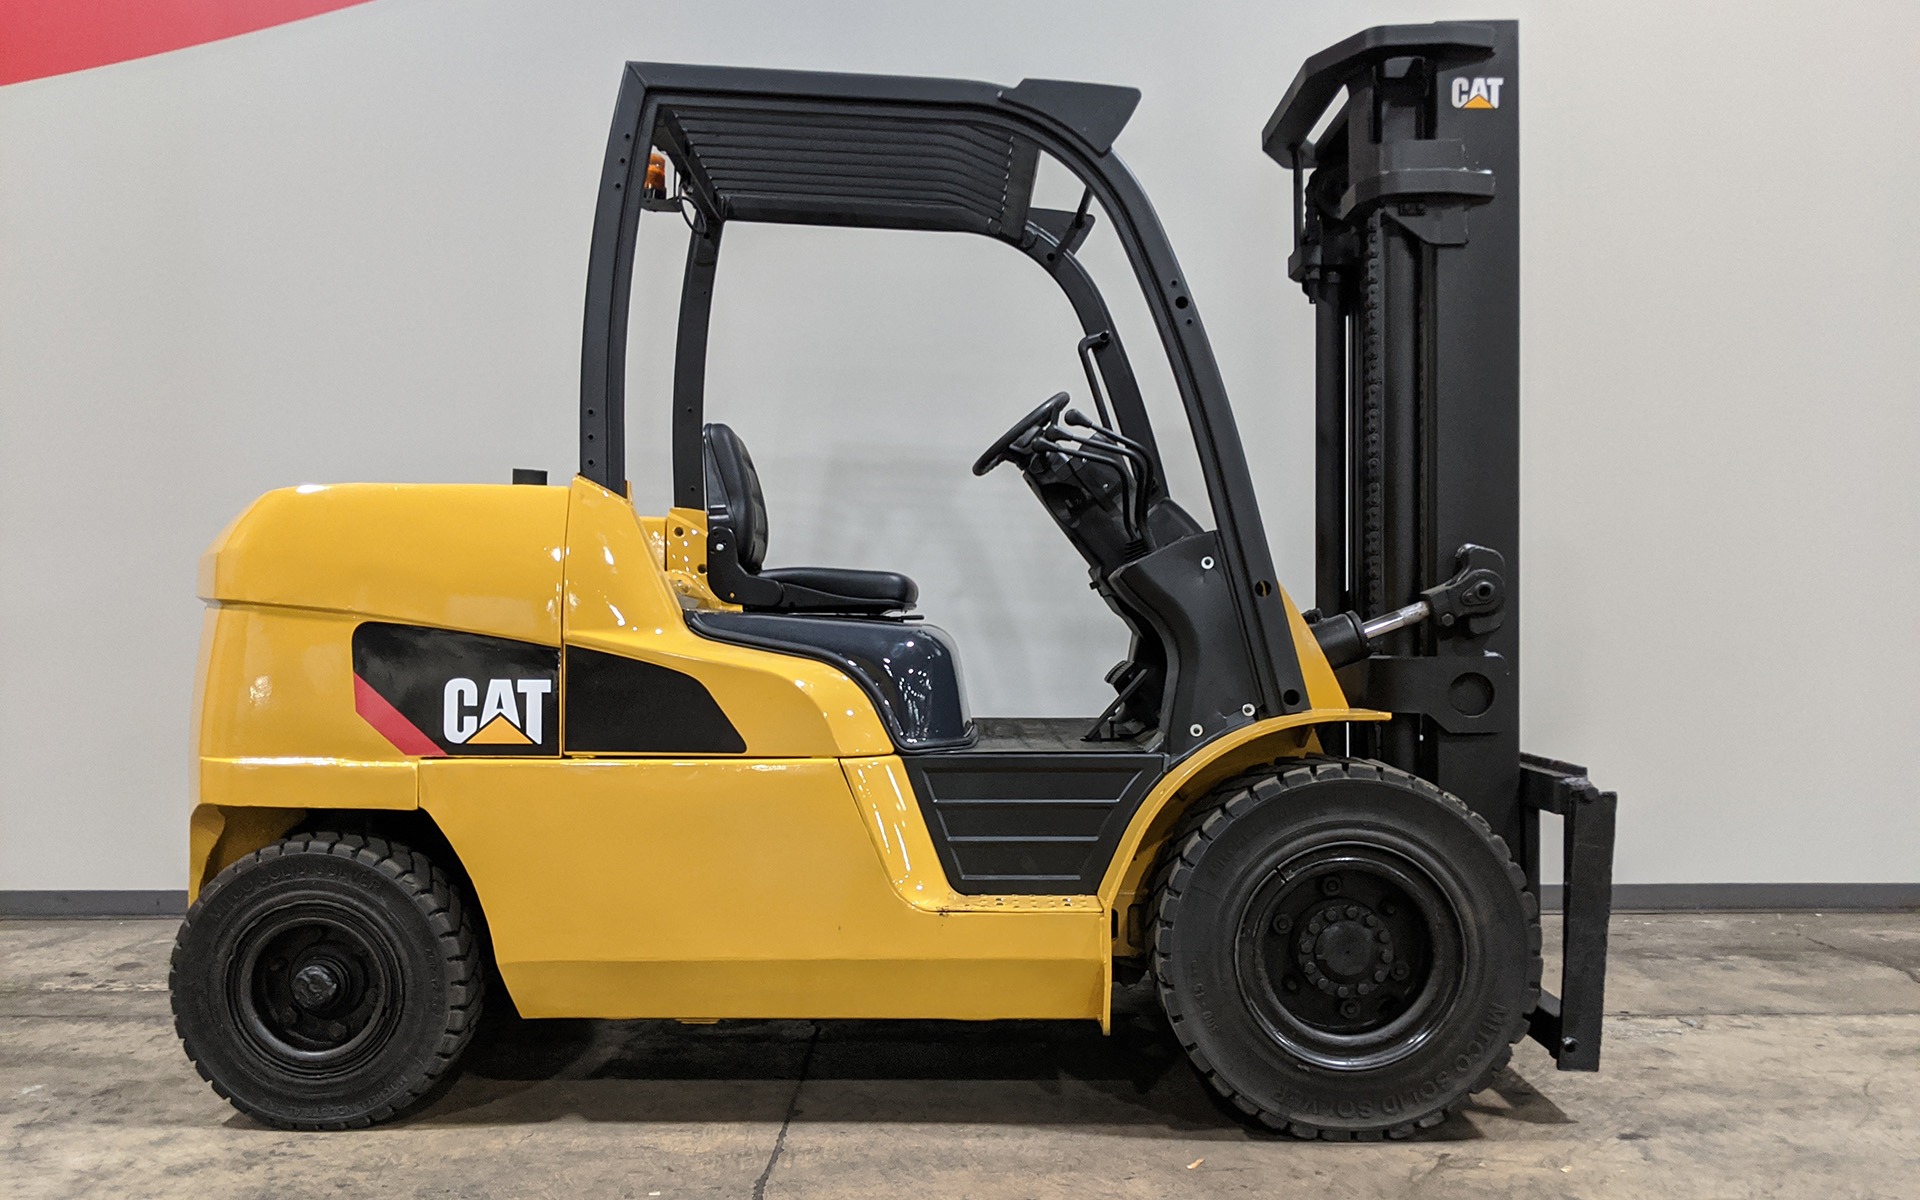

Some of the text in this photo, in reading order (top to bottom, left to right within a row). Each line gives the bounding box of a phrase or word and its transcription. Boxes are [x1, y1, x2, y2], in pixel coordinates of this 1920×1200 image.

[1451, 77, 1504, 109] CAT
[443, 678, 551, 745] CAT
[1455, 1003, 1507, 1073] MITCO
[1381, 1071, 1449, 1116] SOLID
